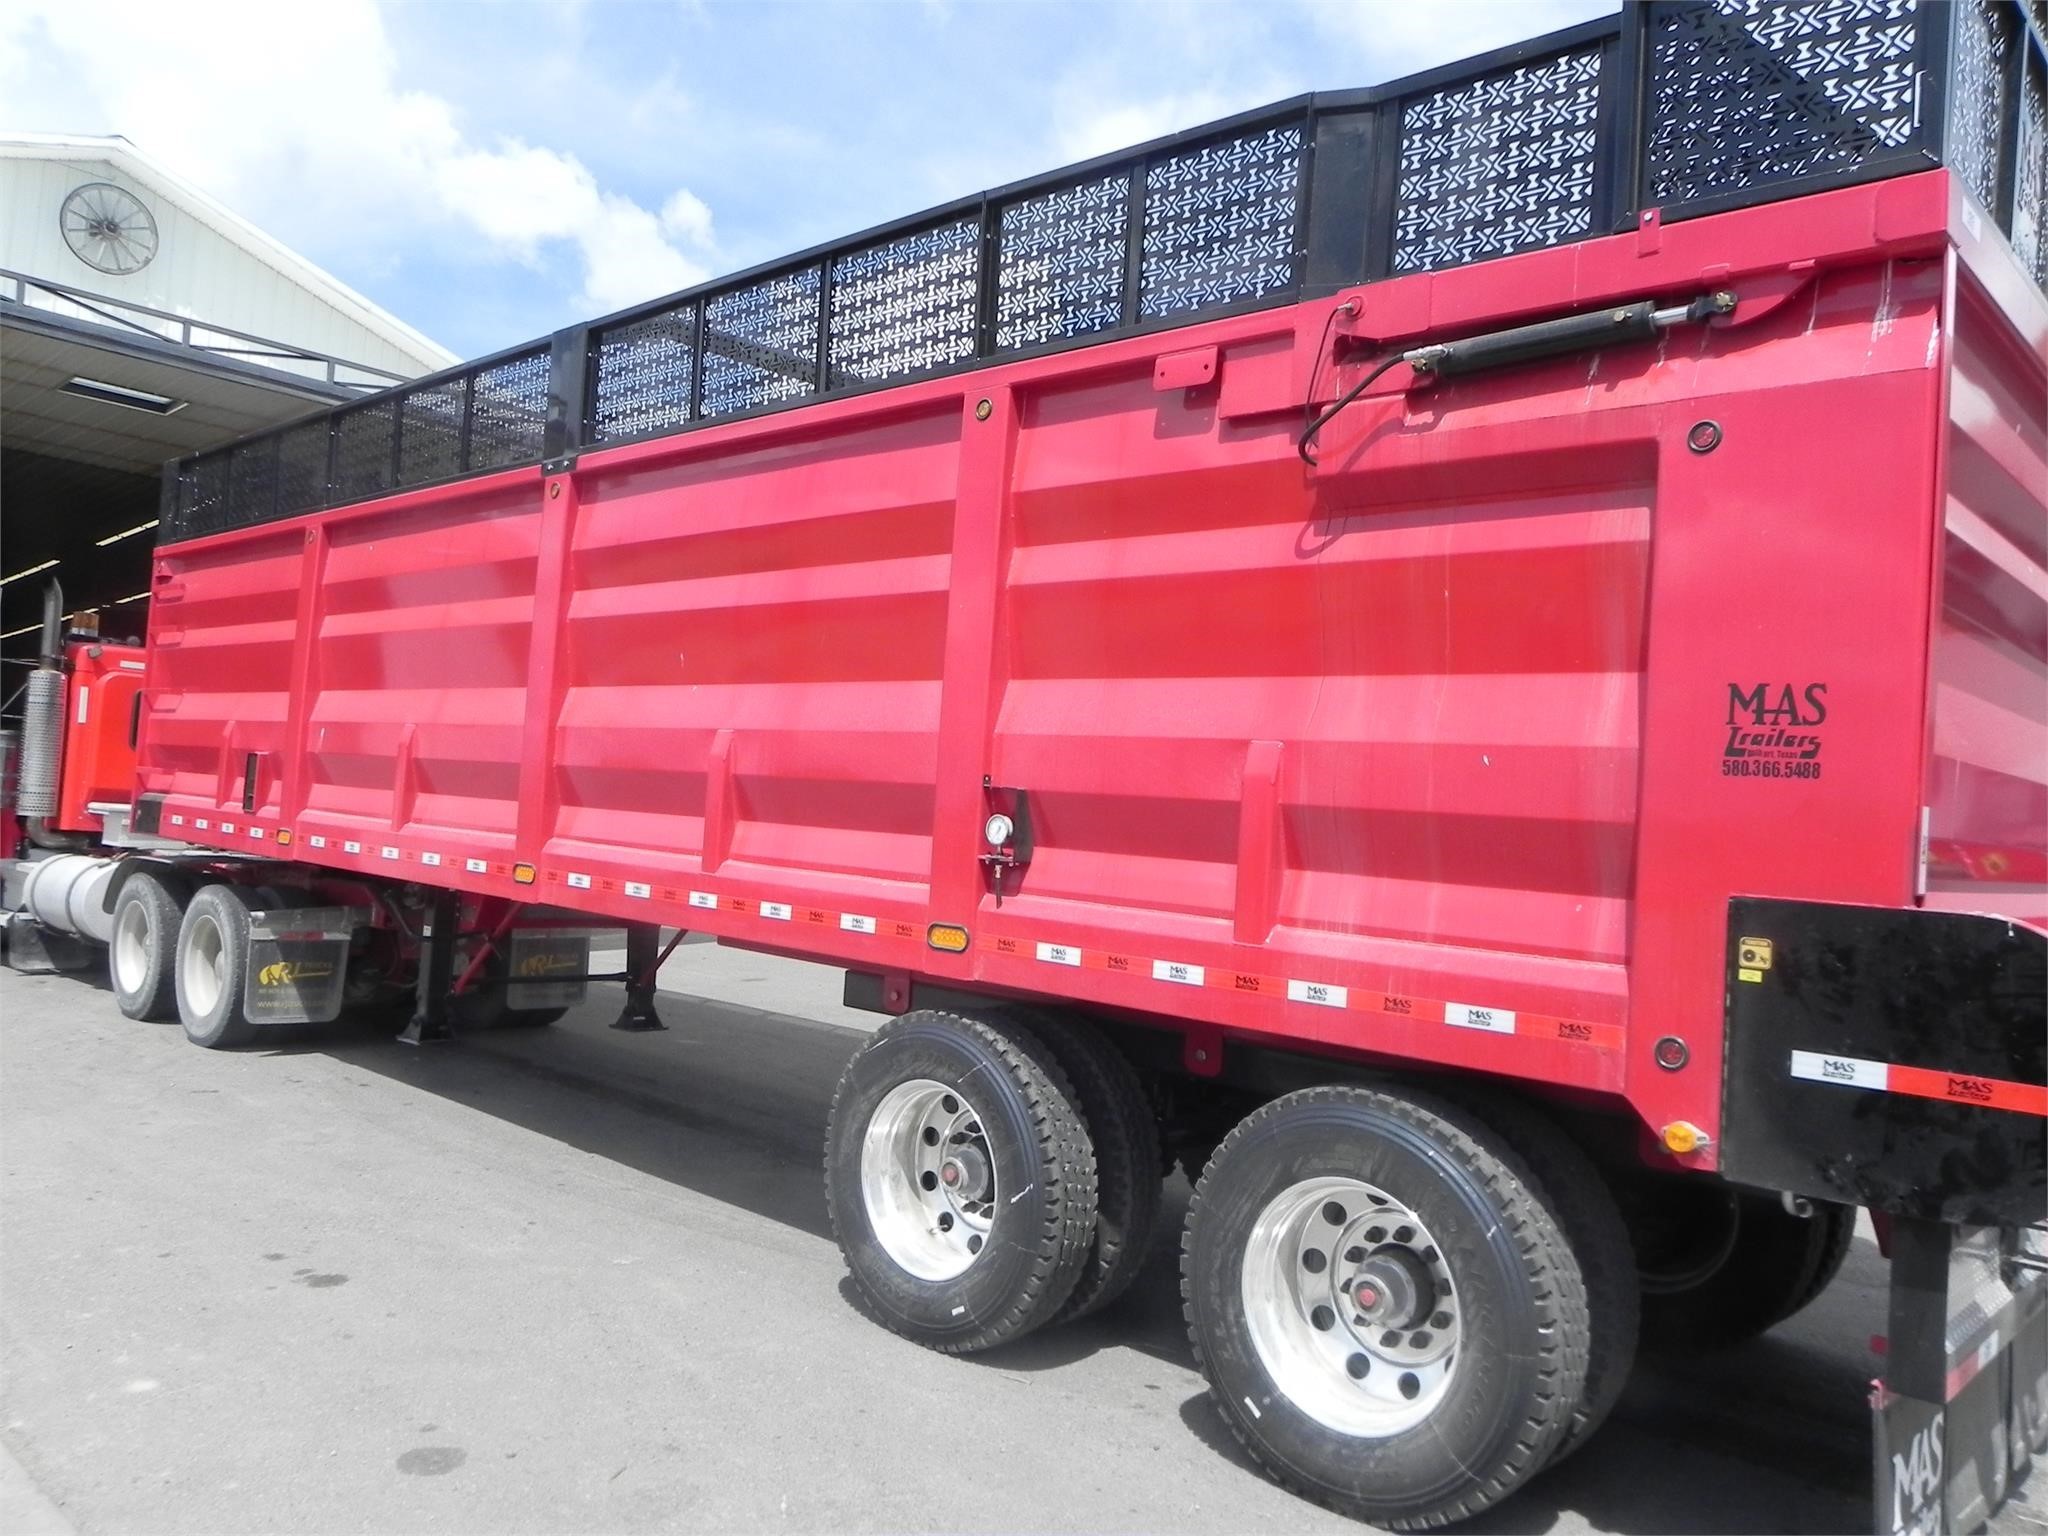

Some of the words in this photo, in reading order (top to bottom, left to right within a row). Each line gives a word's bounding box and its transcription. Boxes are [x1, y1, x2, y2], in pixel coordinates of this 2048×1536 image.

[1726, 683, 1827, 726] MAS
[1724, 727, 1821, 759] Trailers
[1722, 760, 1821, 779] 580.366.5488
[1235, 975, 1260, 986] MAS
[1307, 985, 1328, 996] MAS
[1384, 996, 1412, 1009] MAS
[1468, 1009, 1492, 1020] MAS
[1558, 1022, 1592, 1035] MAS
[1823, 1059, 1856, 1073] MAS
[1948, 1078, 1993, 1094] MAS
[1892, 1411, 1944, 1532] MAS
